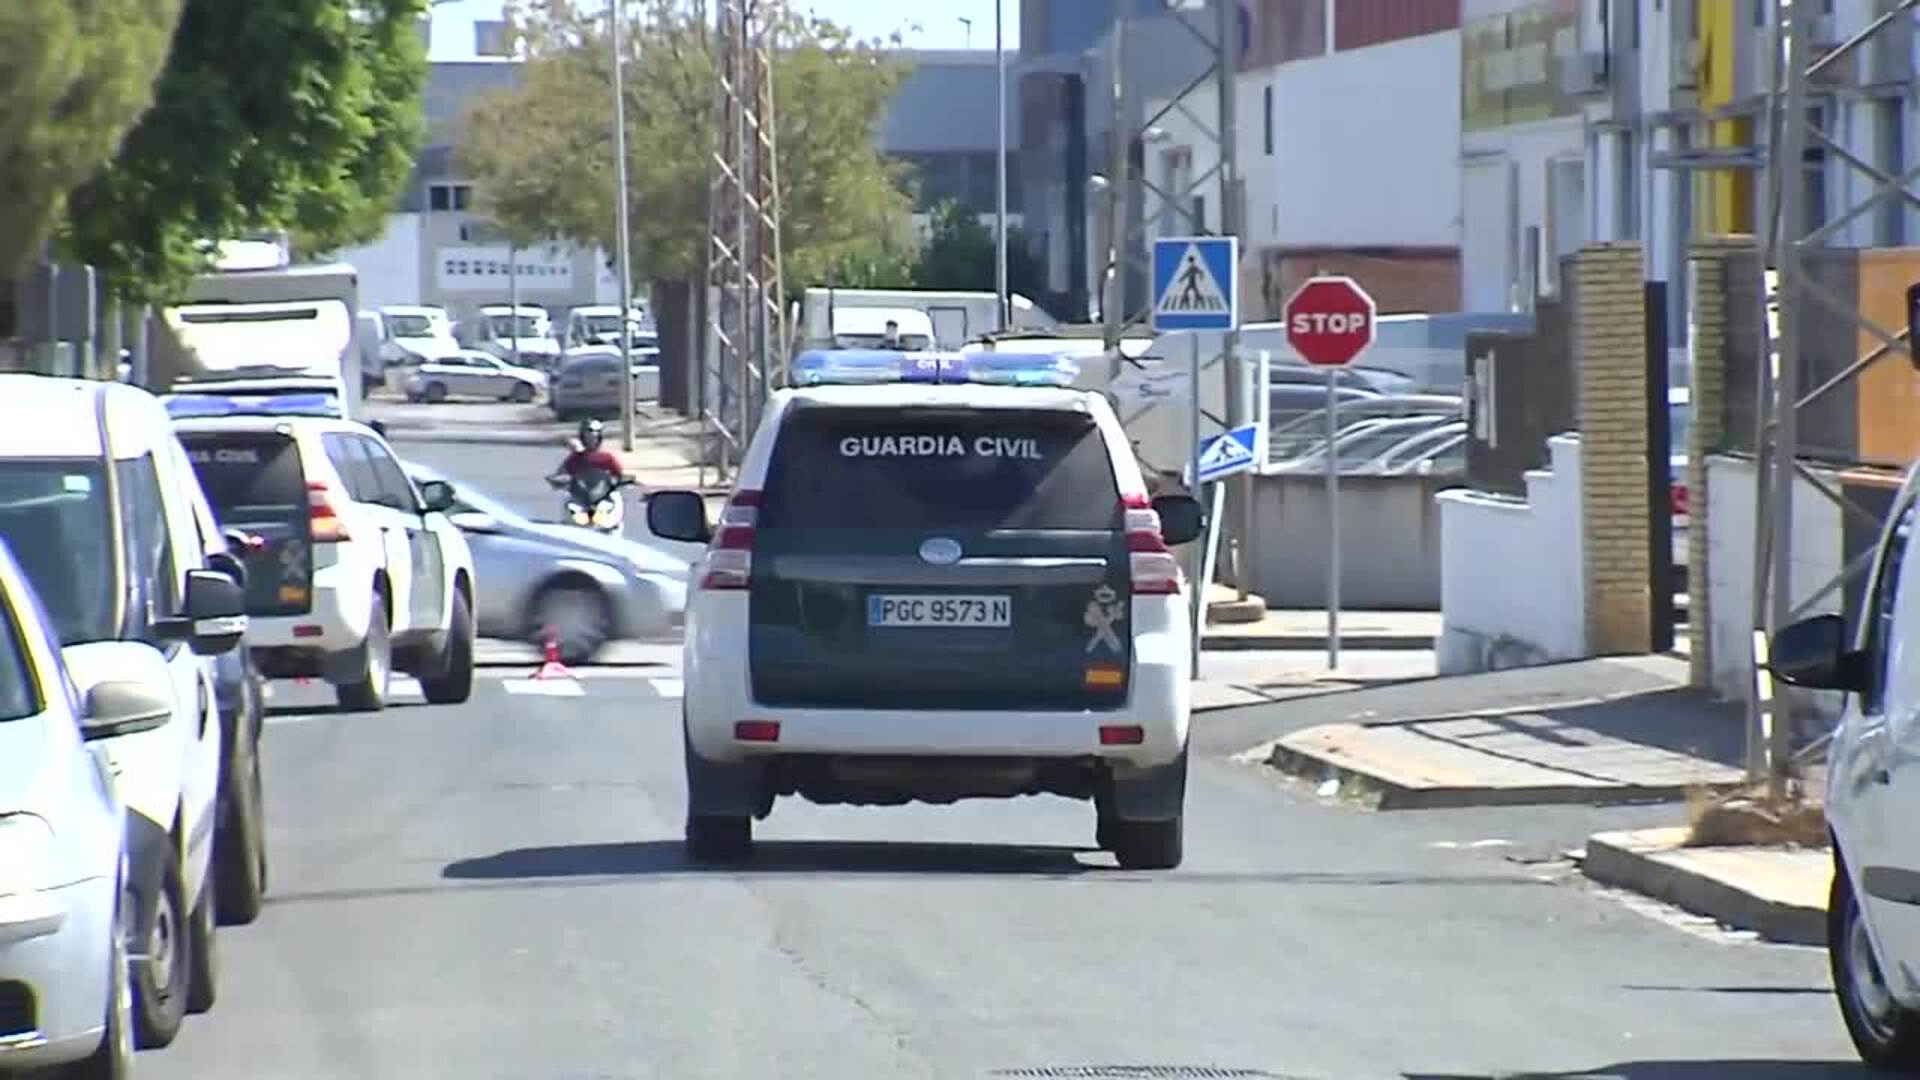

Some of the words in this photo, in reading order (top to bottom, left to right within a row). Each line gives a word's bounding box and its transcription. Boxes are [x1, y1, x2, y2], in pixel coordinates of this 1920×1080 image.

[1292, 313, 1366, 334] STOP
[839, 436, 965, 457] GUARDIA
[974, 437, 1043, 459] CIVIL
[882, 600, 925, 622] PGC
[931, 600, 987, 622] 9573
[993, 600, 1007, 622] N
